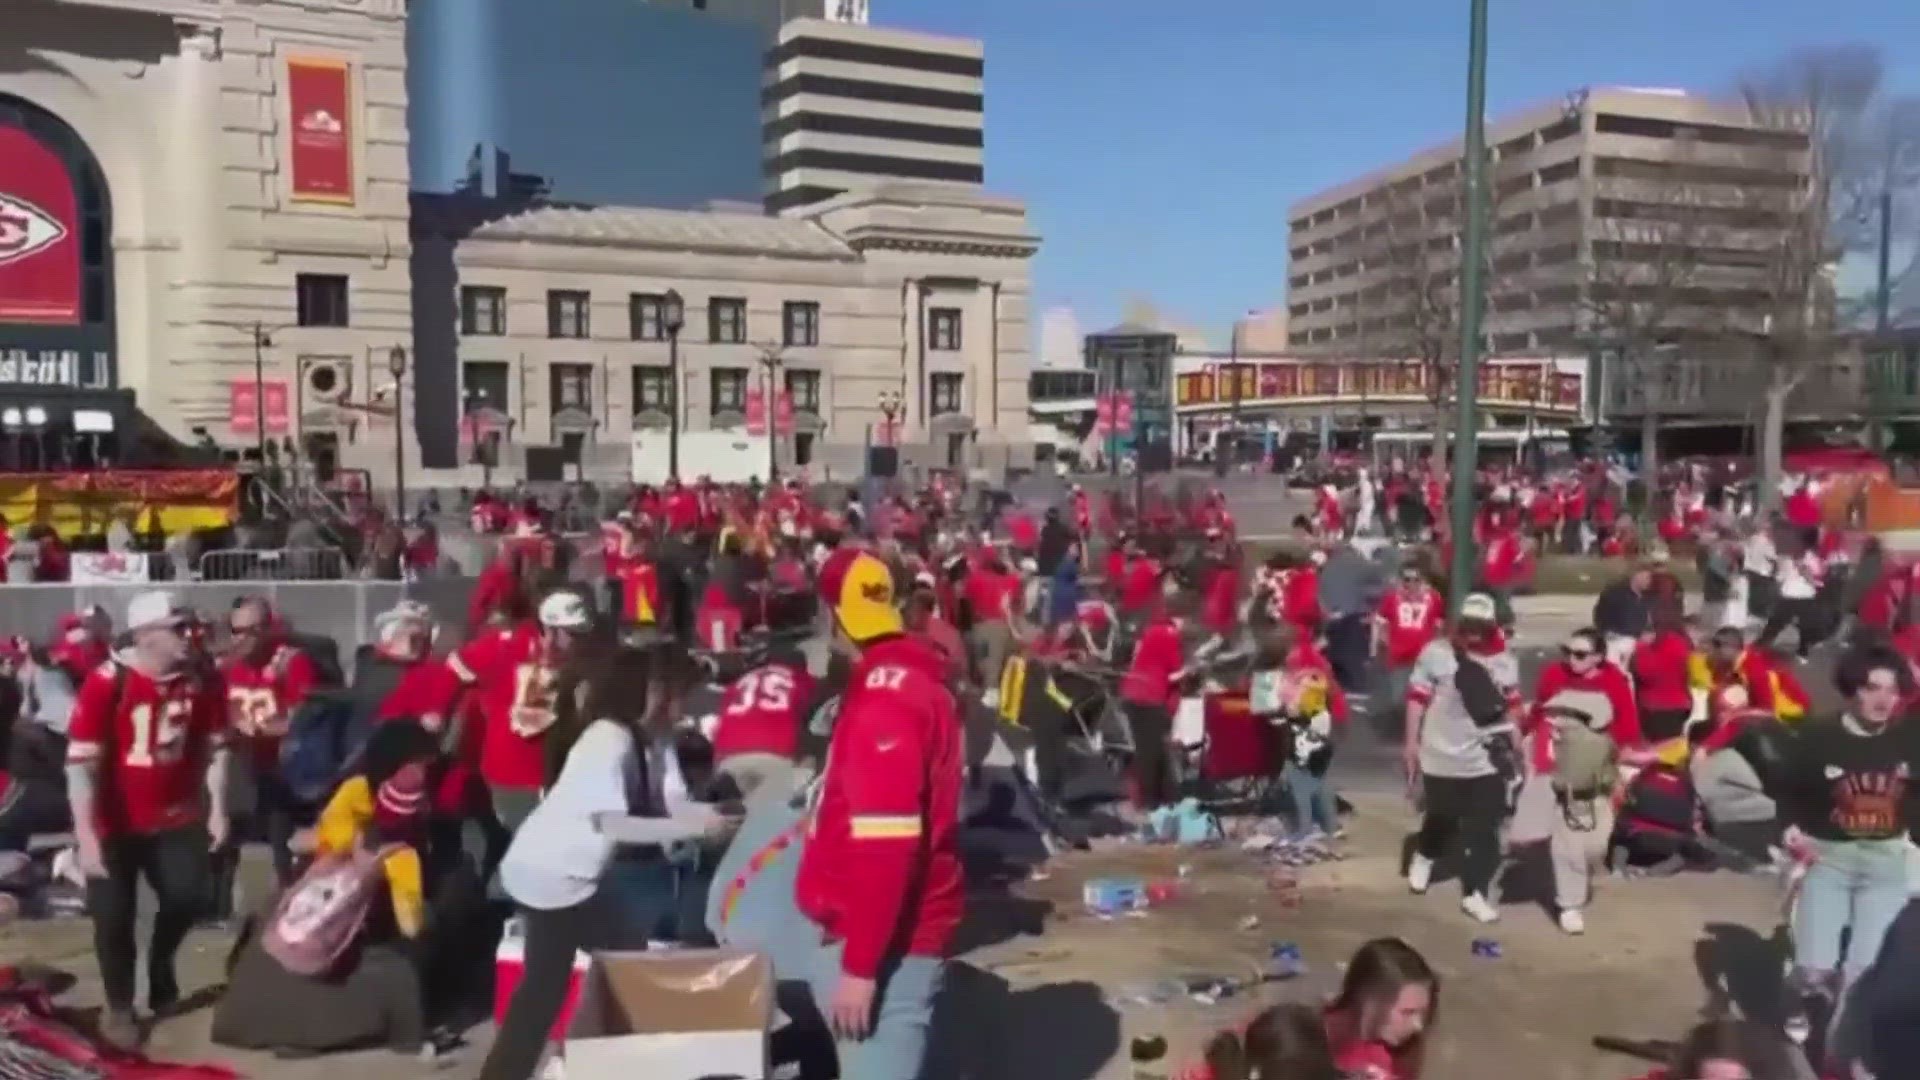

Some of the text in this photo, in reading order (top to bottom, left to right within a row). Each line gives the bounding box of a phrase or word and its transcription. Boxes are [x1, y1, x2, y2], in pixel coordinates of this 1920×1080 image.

[1397, 602, 1427, 629] 87
[728, 664, 797, 716] 35
[865, 665, 908, 691] 87
